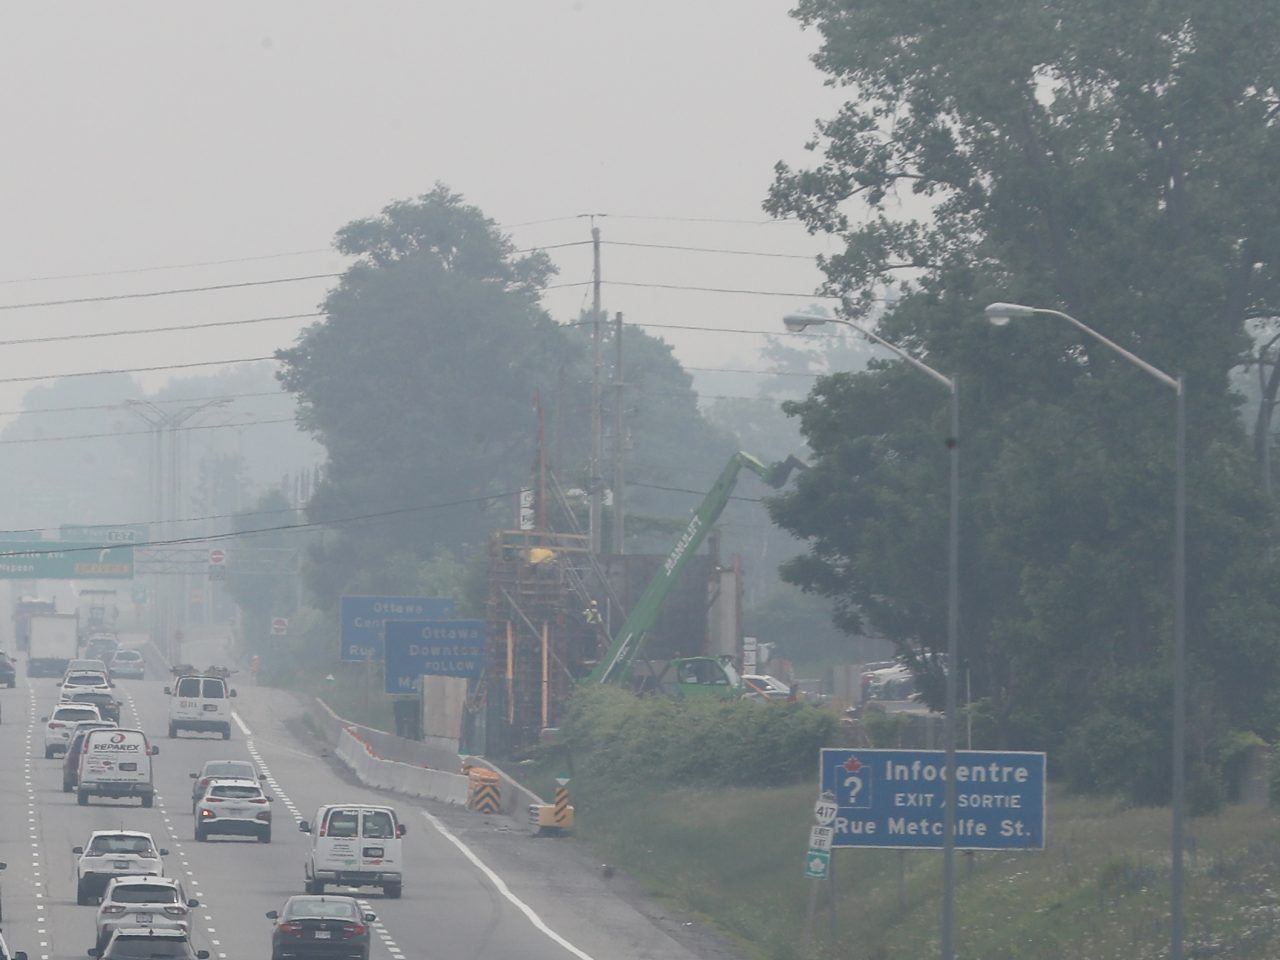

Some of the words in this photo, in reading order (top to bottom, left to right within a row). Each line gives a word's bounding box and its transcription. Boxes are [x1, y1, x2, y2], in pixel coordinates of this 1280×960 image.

[373, 602, 423, 614] Ottawa
[422, 626, 479, 639] Ottawa
[408, 645, 486, 657] Downt
[425, 661, 475, 671] FOLLOW
[885, 760, 1029, 782] Infocentre
[895, 793, 934, 807] EXIT
[958, 794, 1021, 809] SORTIE
[816, 806, 836, 817] 417
[835, 817, 877, 833] Rue
[888, 817, 988, 836] Metclfe
[1000, 819, 1032, 837] St.
